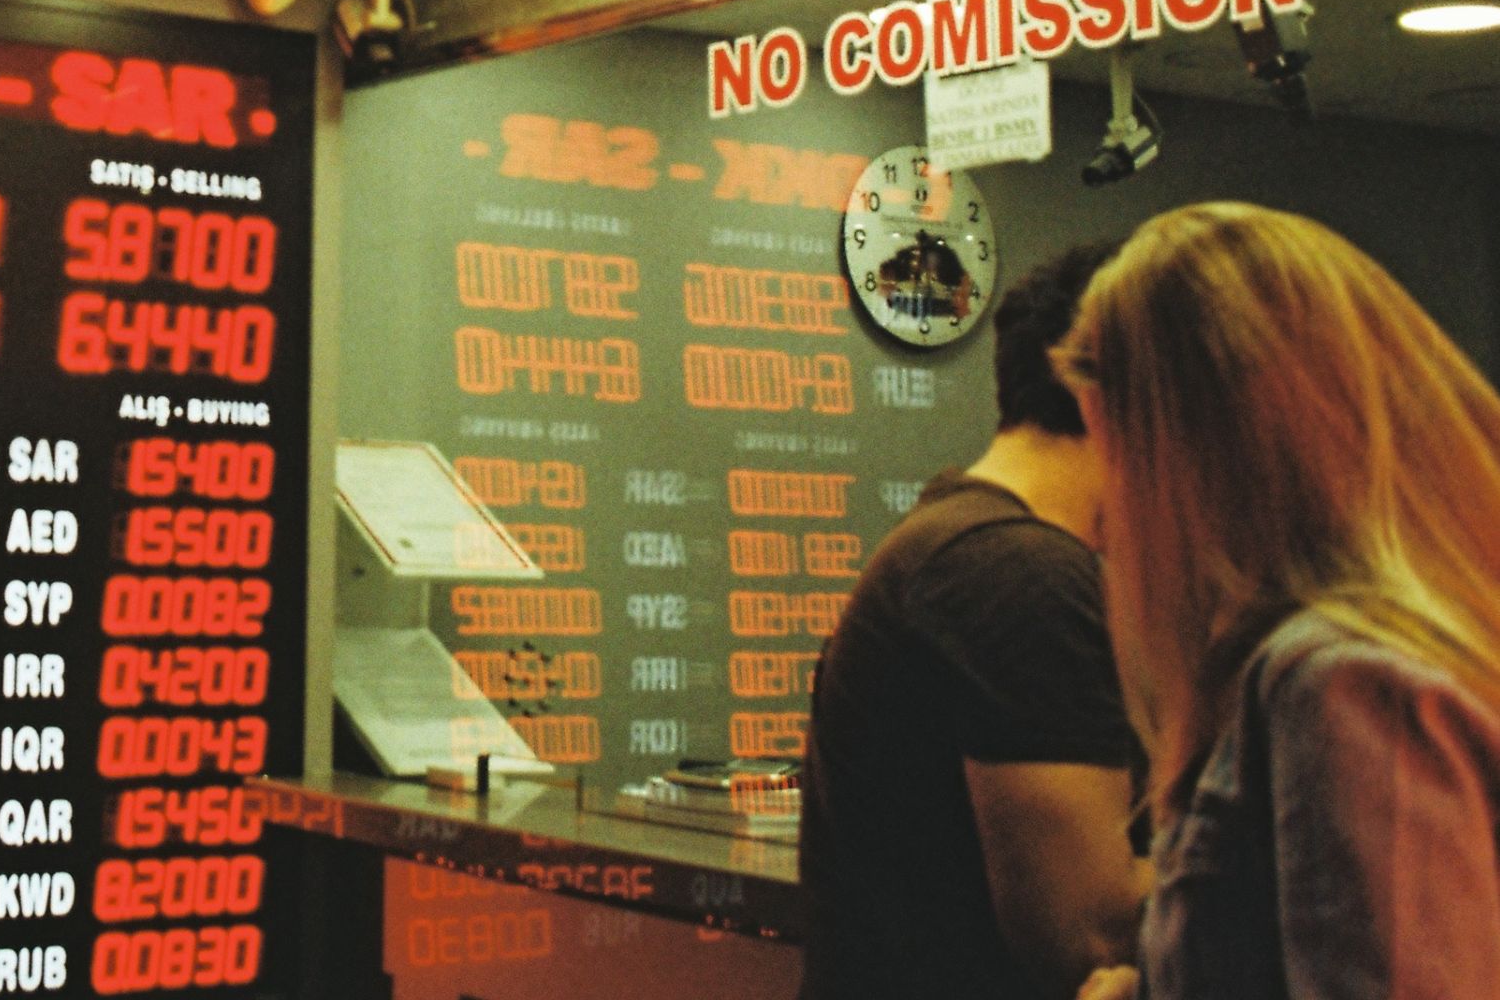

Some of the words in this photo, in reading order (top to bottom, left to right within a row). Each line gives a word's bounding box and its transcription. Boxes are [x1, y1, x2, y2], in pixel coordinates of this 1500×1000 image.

[708, 27, 805, 119] NO
[51, 50, 237, 148] SAR
[90, 158, 155, 195] SATIŞ
[170, 167, 262, 201] SELLING
[119, 394, 170, 427] ALIŞ
[187, 398, 270, 427] BUYING
[8, 436, 78, 483] SAR
[6, 508, 78, 554] AED
[4, 580, 73, 626] SYP
[3, 653, 65, 698] IRR
[1, 726, 64, 772] IQR
